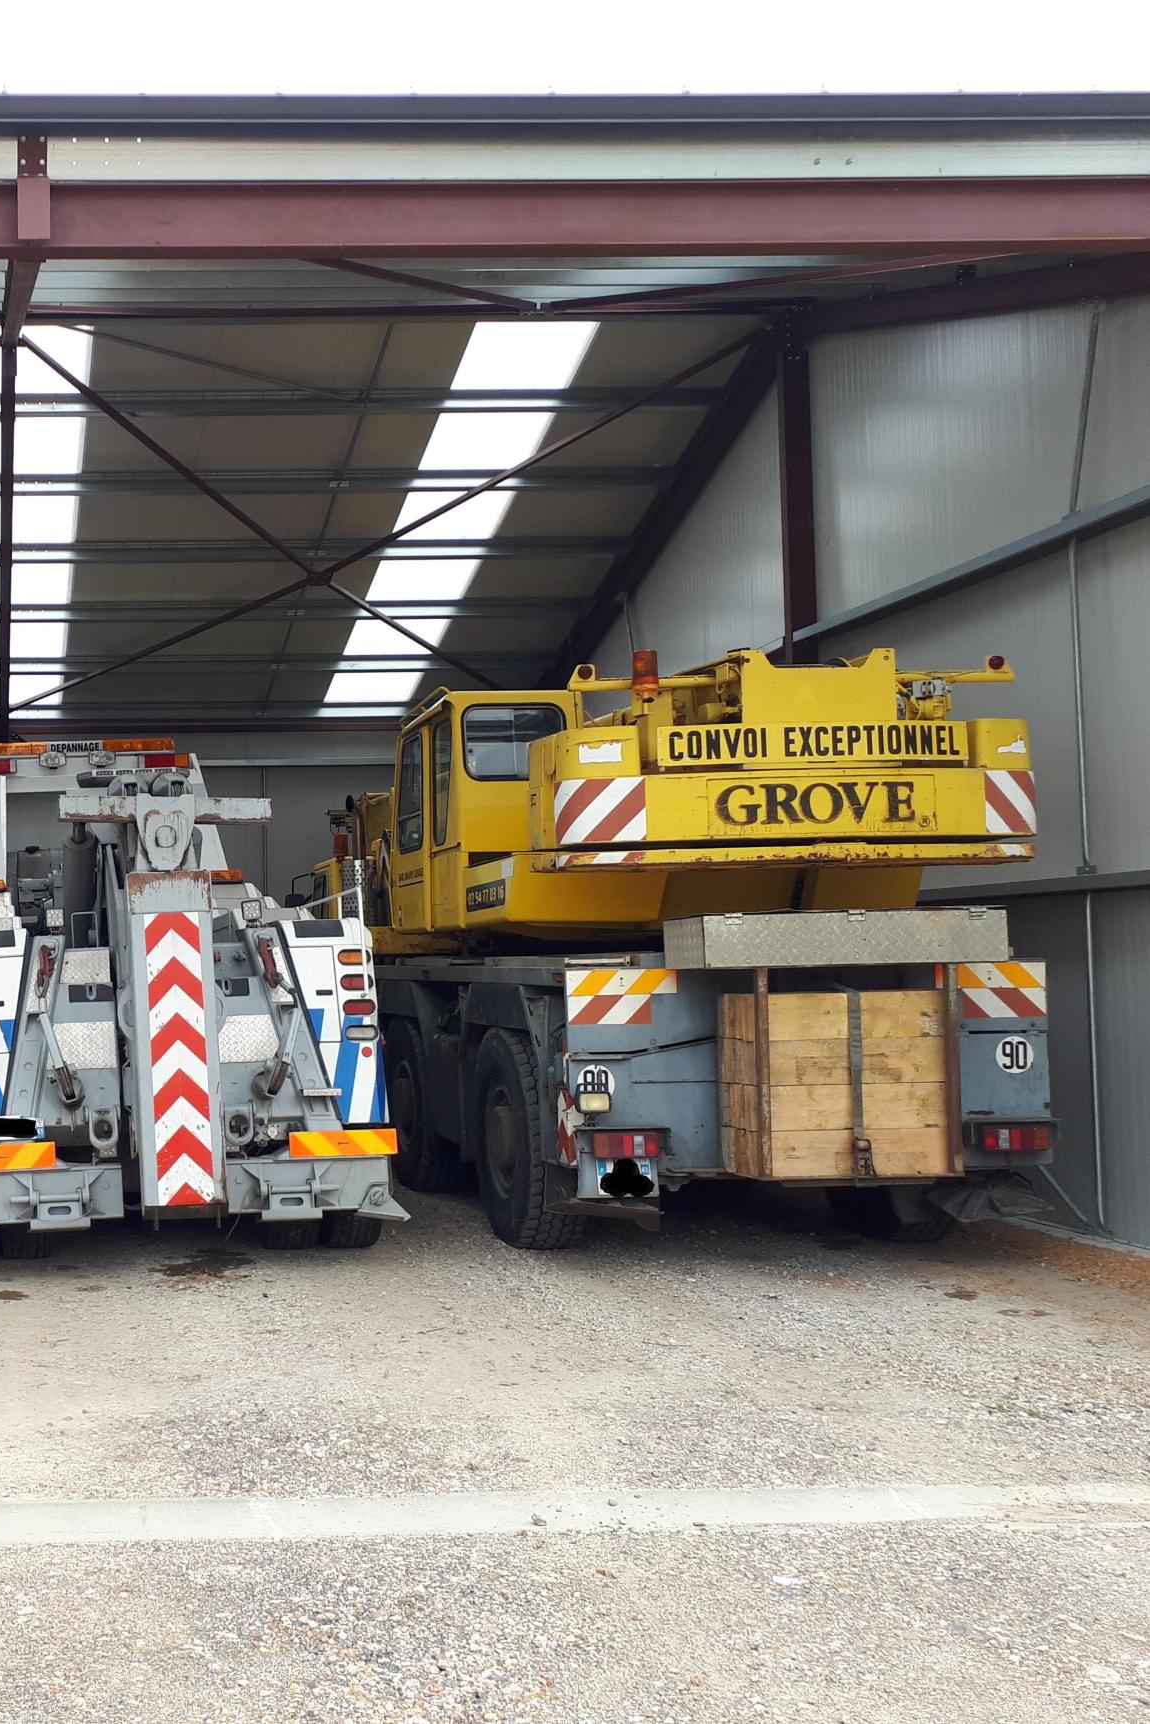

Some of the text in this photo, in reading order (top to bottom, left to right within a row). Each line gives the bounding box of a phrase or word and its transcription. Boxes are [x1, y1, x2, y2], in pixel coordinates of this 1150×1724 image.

[50, 742, 100, 753] DEPANNAGE
[669, 724, 960, 761] CONVOI EXCEPTIONNEL
[715, 781, 916, 827] GROVE
[1002, 1040, 1028, 1070] 90
